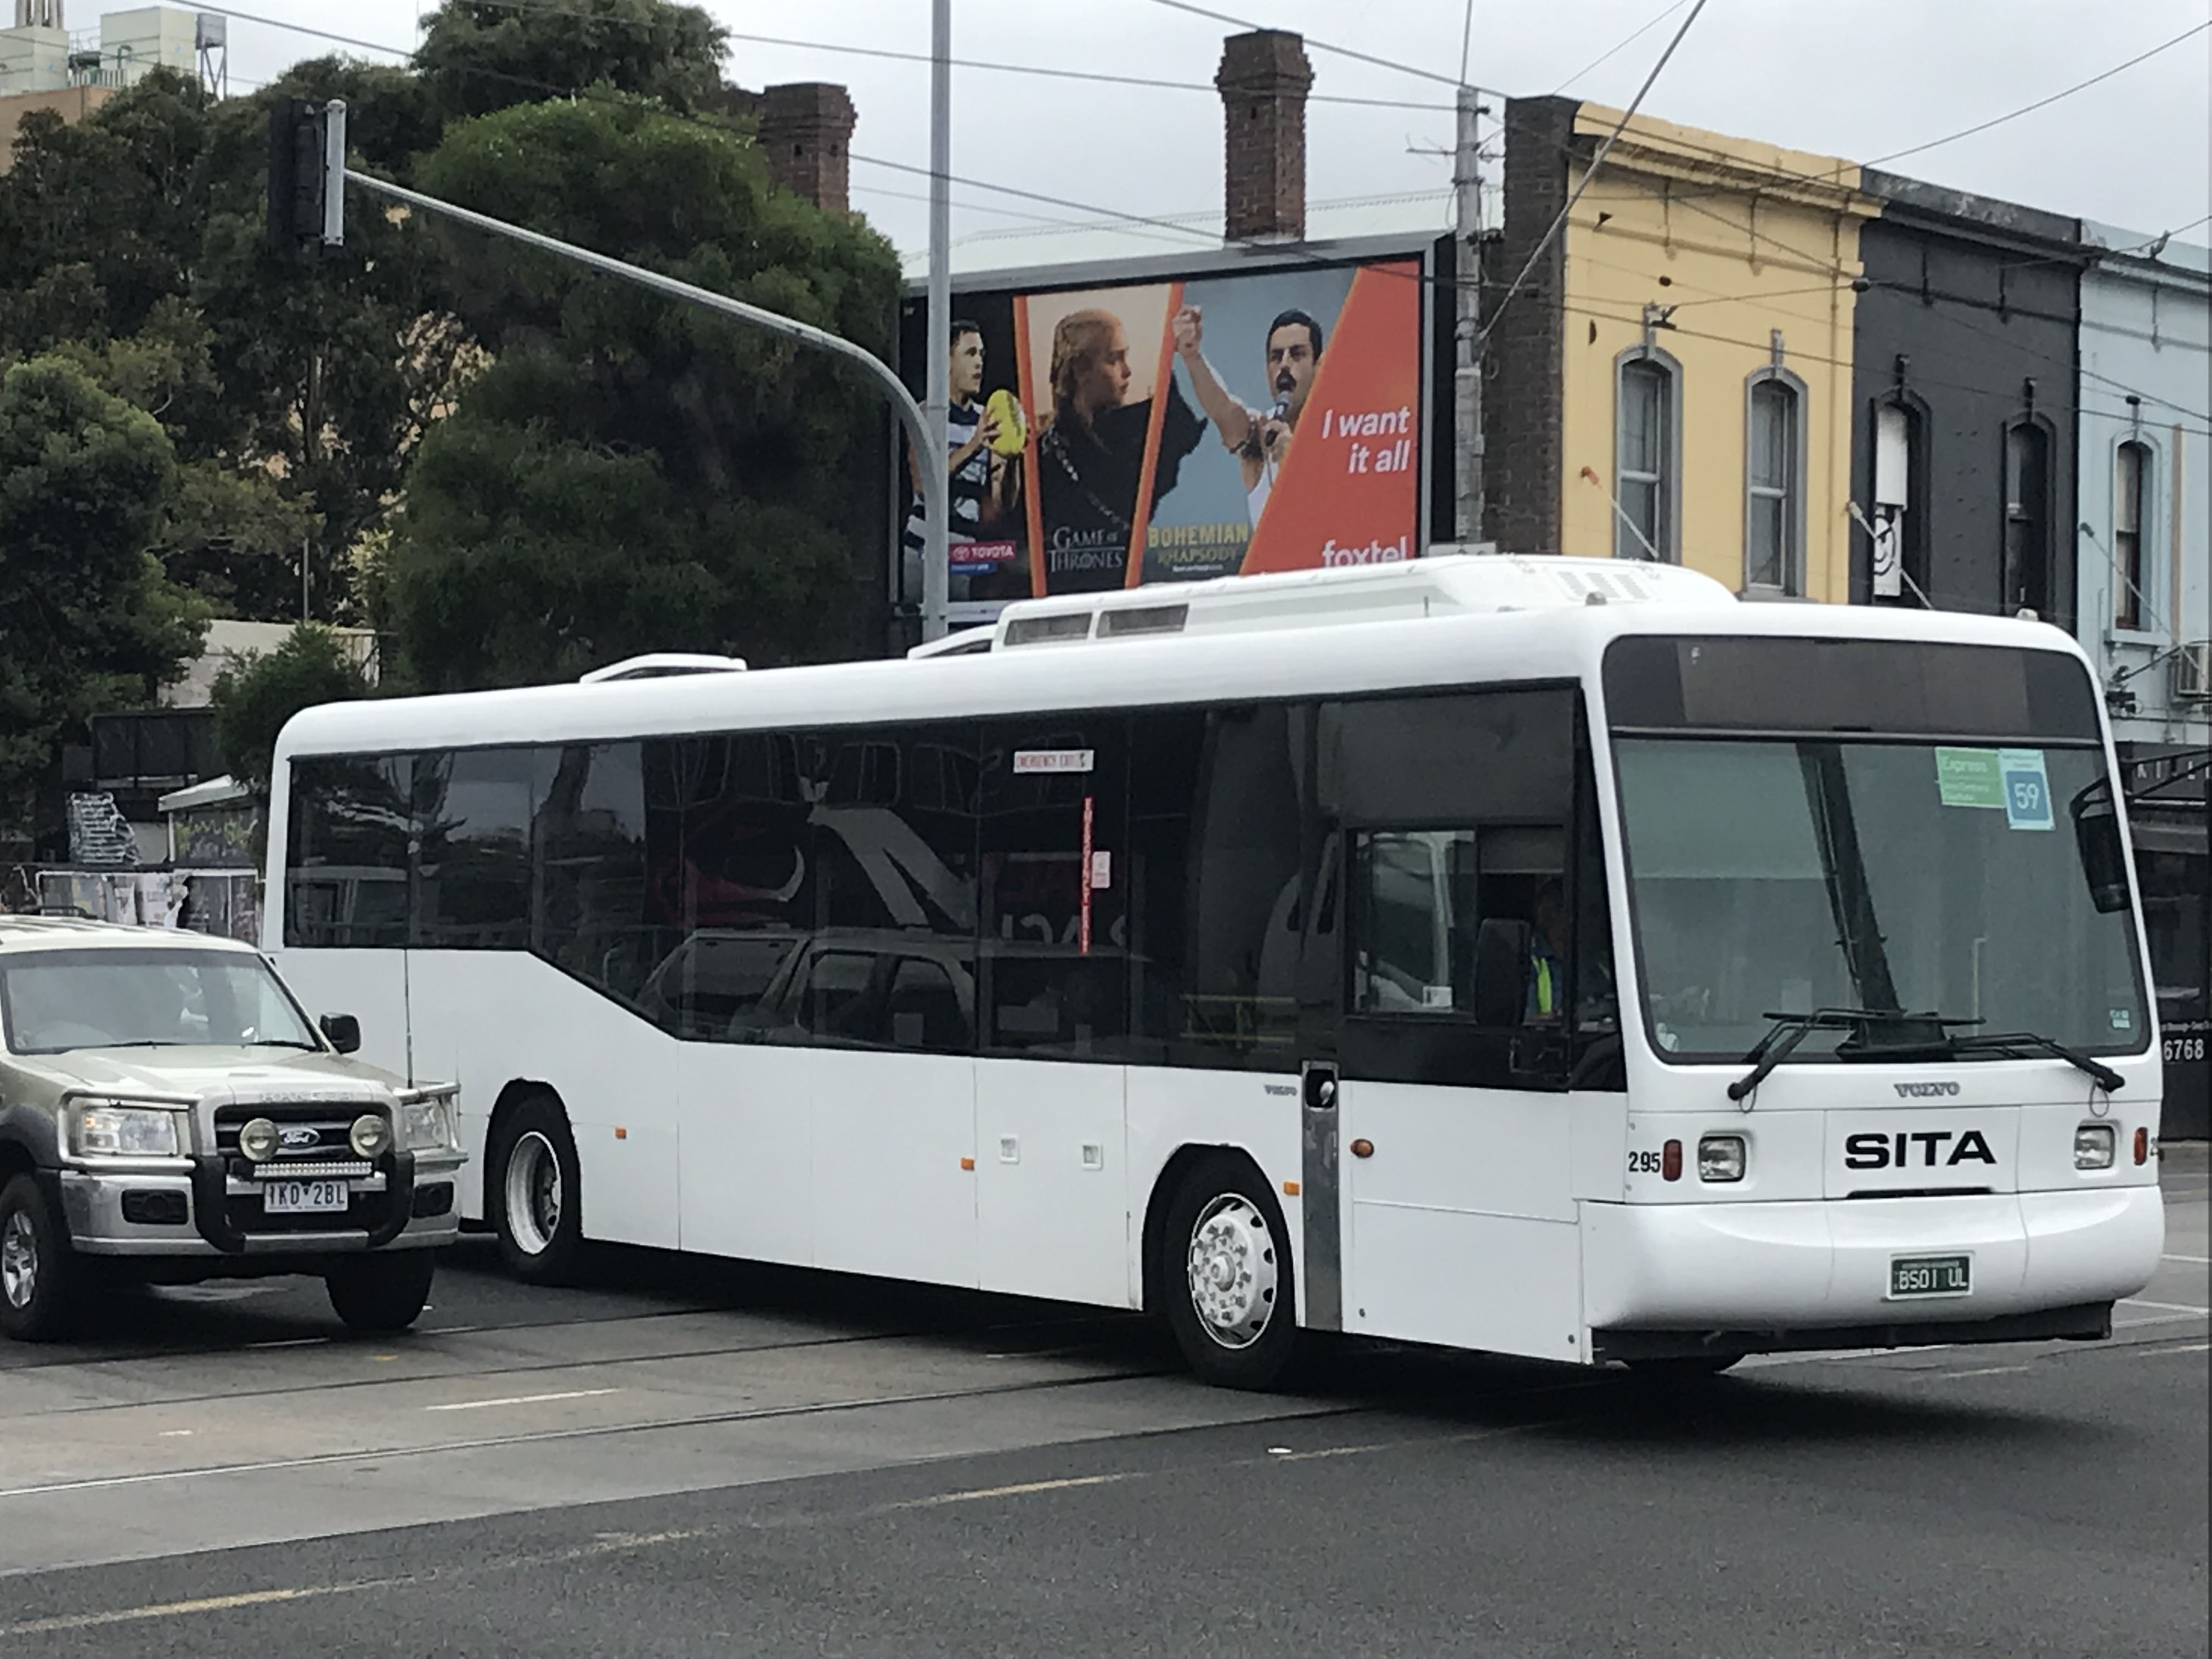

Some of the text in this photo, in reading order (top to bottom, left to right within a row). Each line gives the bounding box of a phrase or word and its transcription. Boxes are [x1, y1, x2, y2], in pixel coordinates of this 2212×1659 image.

[1322, 406, 1411, 439] I want
[1348, 439, 1411, 474] it all
[1052, 526, 1102, 549] GAME
[1147, 523, 1249, 548] BOHEMIAN
[971, 545, 1015, 560] TOYOTA
[1048, 549, 1122, 573] THRONES
[1322, 535, 1408, 567] foxtel
[2014, 783, 2039, 809] 59
[2163, 1038, 2204, 1061] 6768
[1893, 1081, 1960, 1098] VOLVO
[283, 1131, 310, 1144] Ford
[1845, 1130, 1997, 1169] SITA
[1628, 1150, 1661, 1173] 295
[313, 1183, 345, 1205] 2BL
[1948, 1267, 1968, 1287] UL
